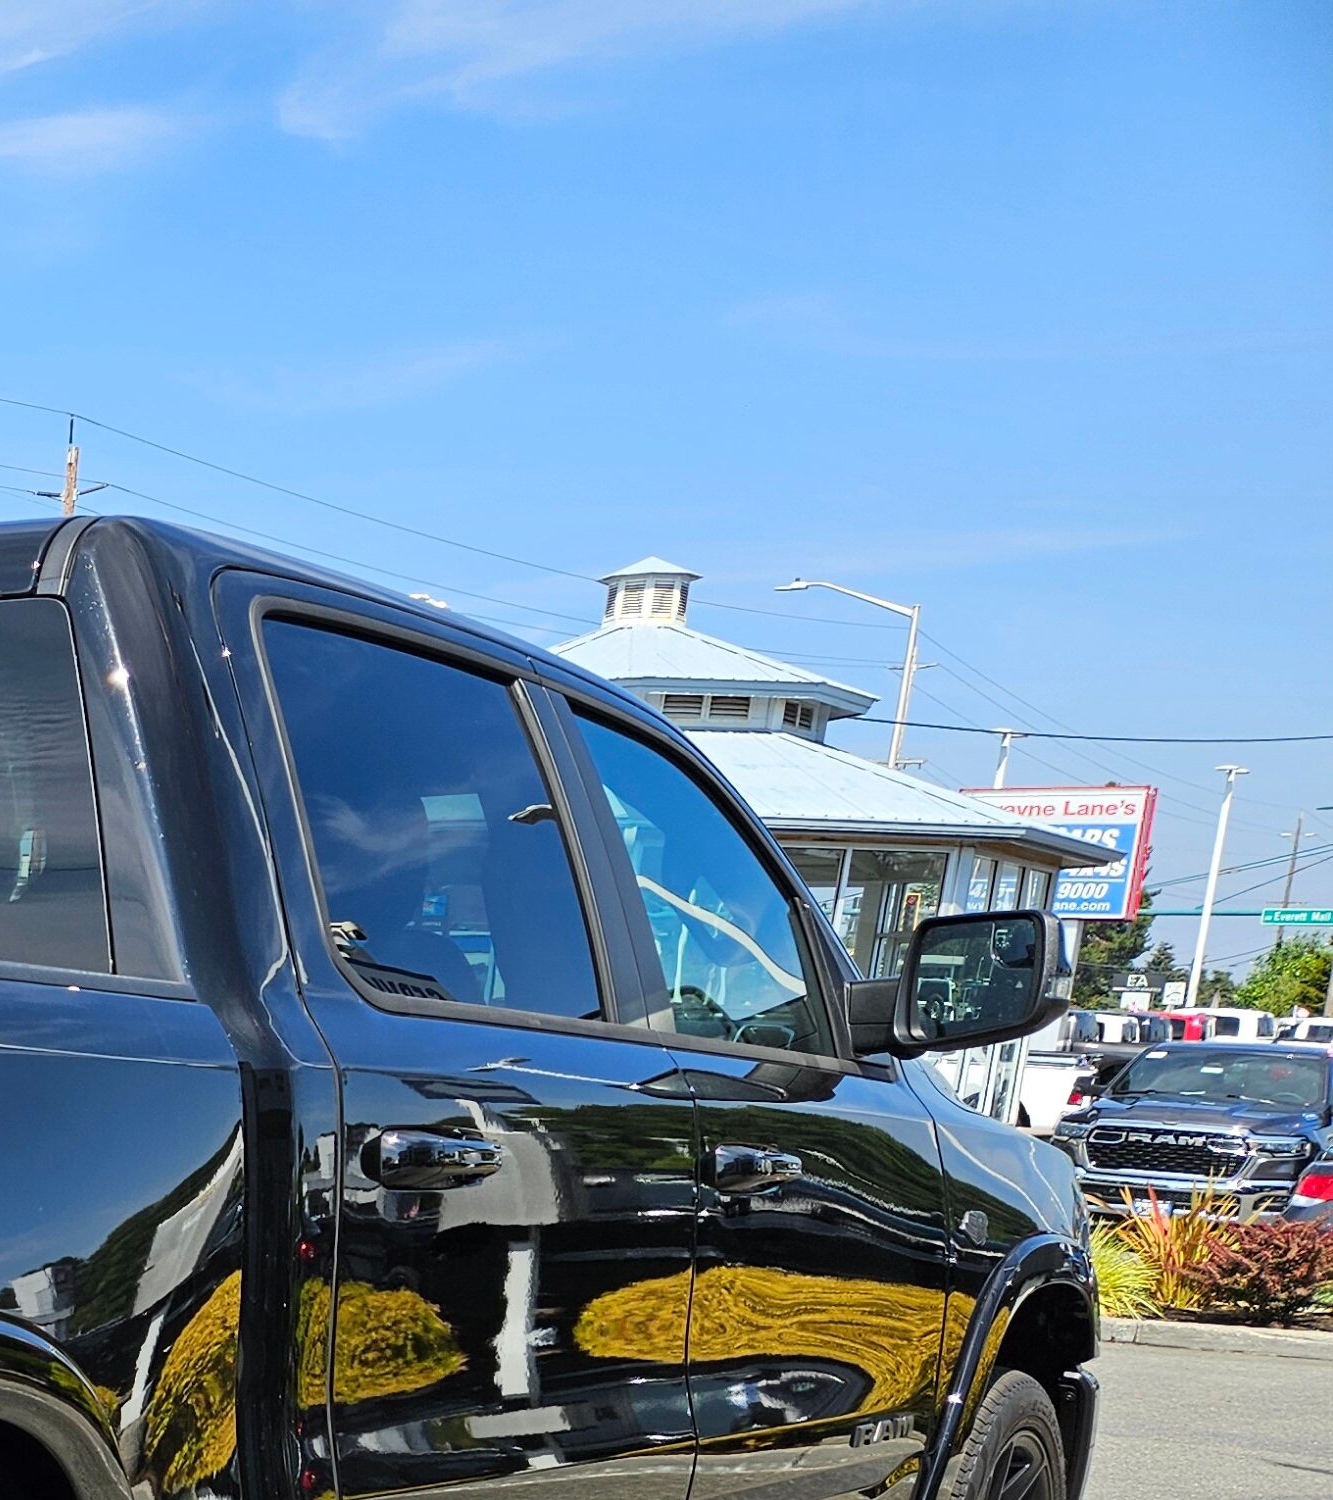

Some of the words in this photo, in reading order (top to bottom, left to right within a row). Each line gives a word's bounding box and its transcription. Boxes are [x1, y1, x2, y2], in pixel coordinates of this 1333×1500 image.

[1063, 800, 1137, 816] Lane's
[1056, 882, 1109, 899] 9000
[1274, 911, 1307, 921] Everett
[1128, 1132, 1206, 1147] RAM
[850, 1416, 914, 1447] RAM
